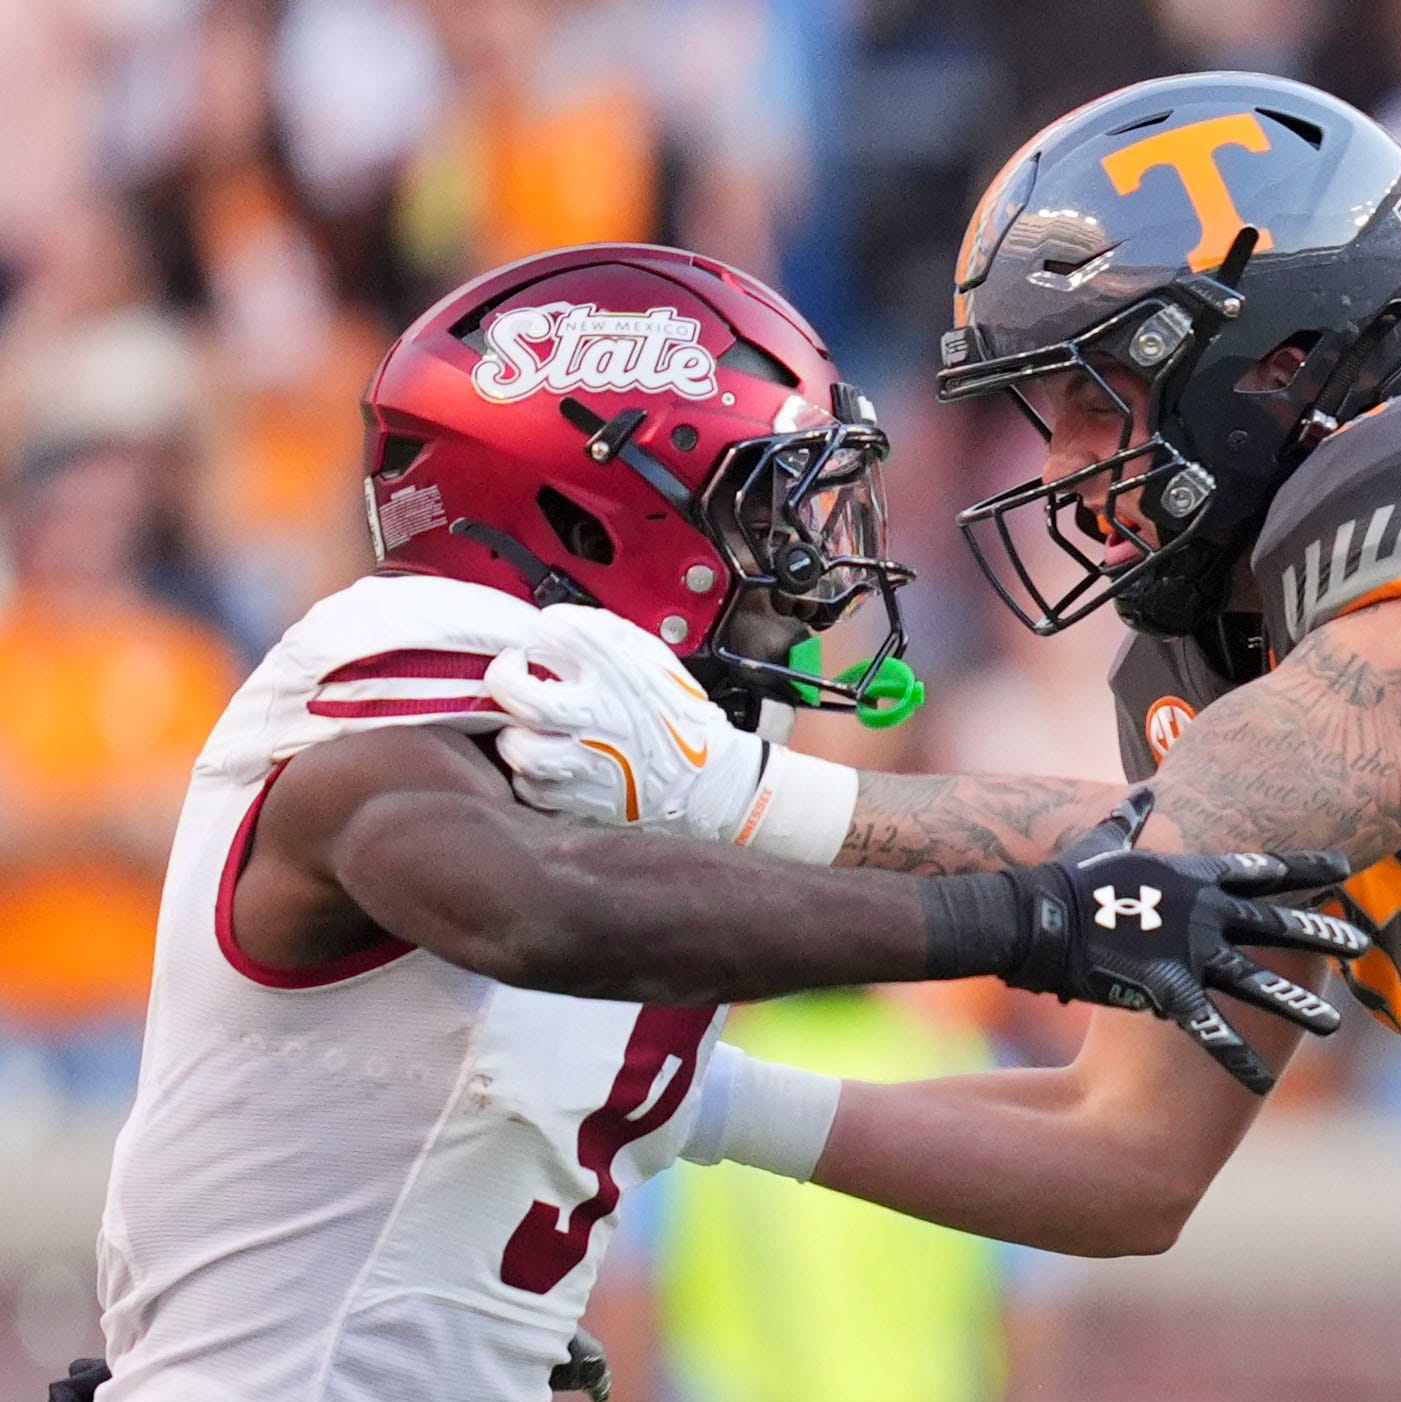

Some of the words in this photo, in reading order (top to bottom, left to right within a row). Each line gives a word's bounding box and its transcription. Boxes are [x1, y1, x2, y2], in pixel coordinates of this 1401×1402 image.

[1101, 112, 1274, 274] T
[472, 301, 718, 403] State
[565, 320, 607, 332] NEW
[615, 321, 690, 337] MEXICO
